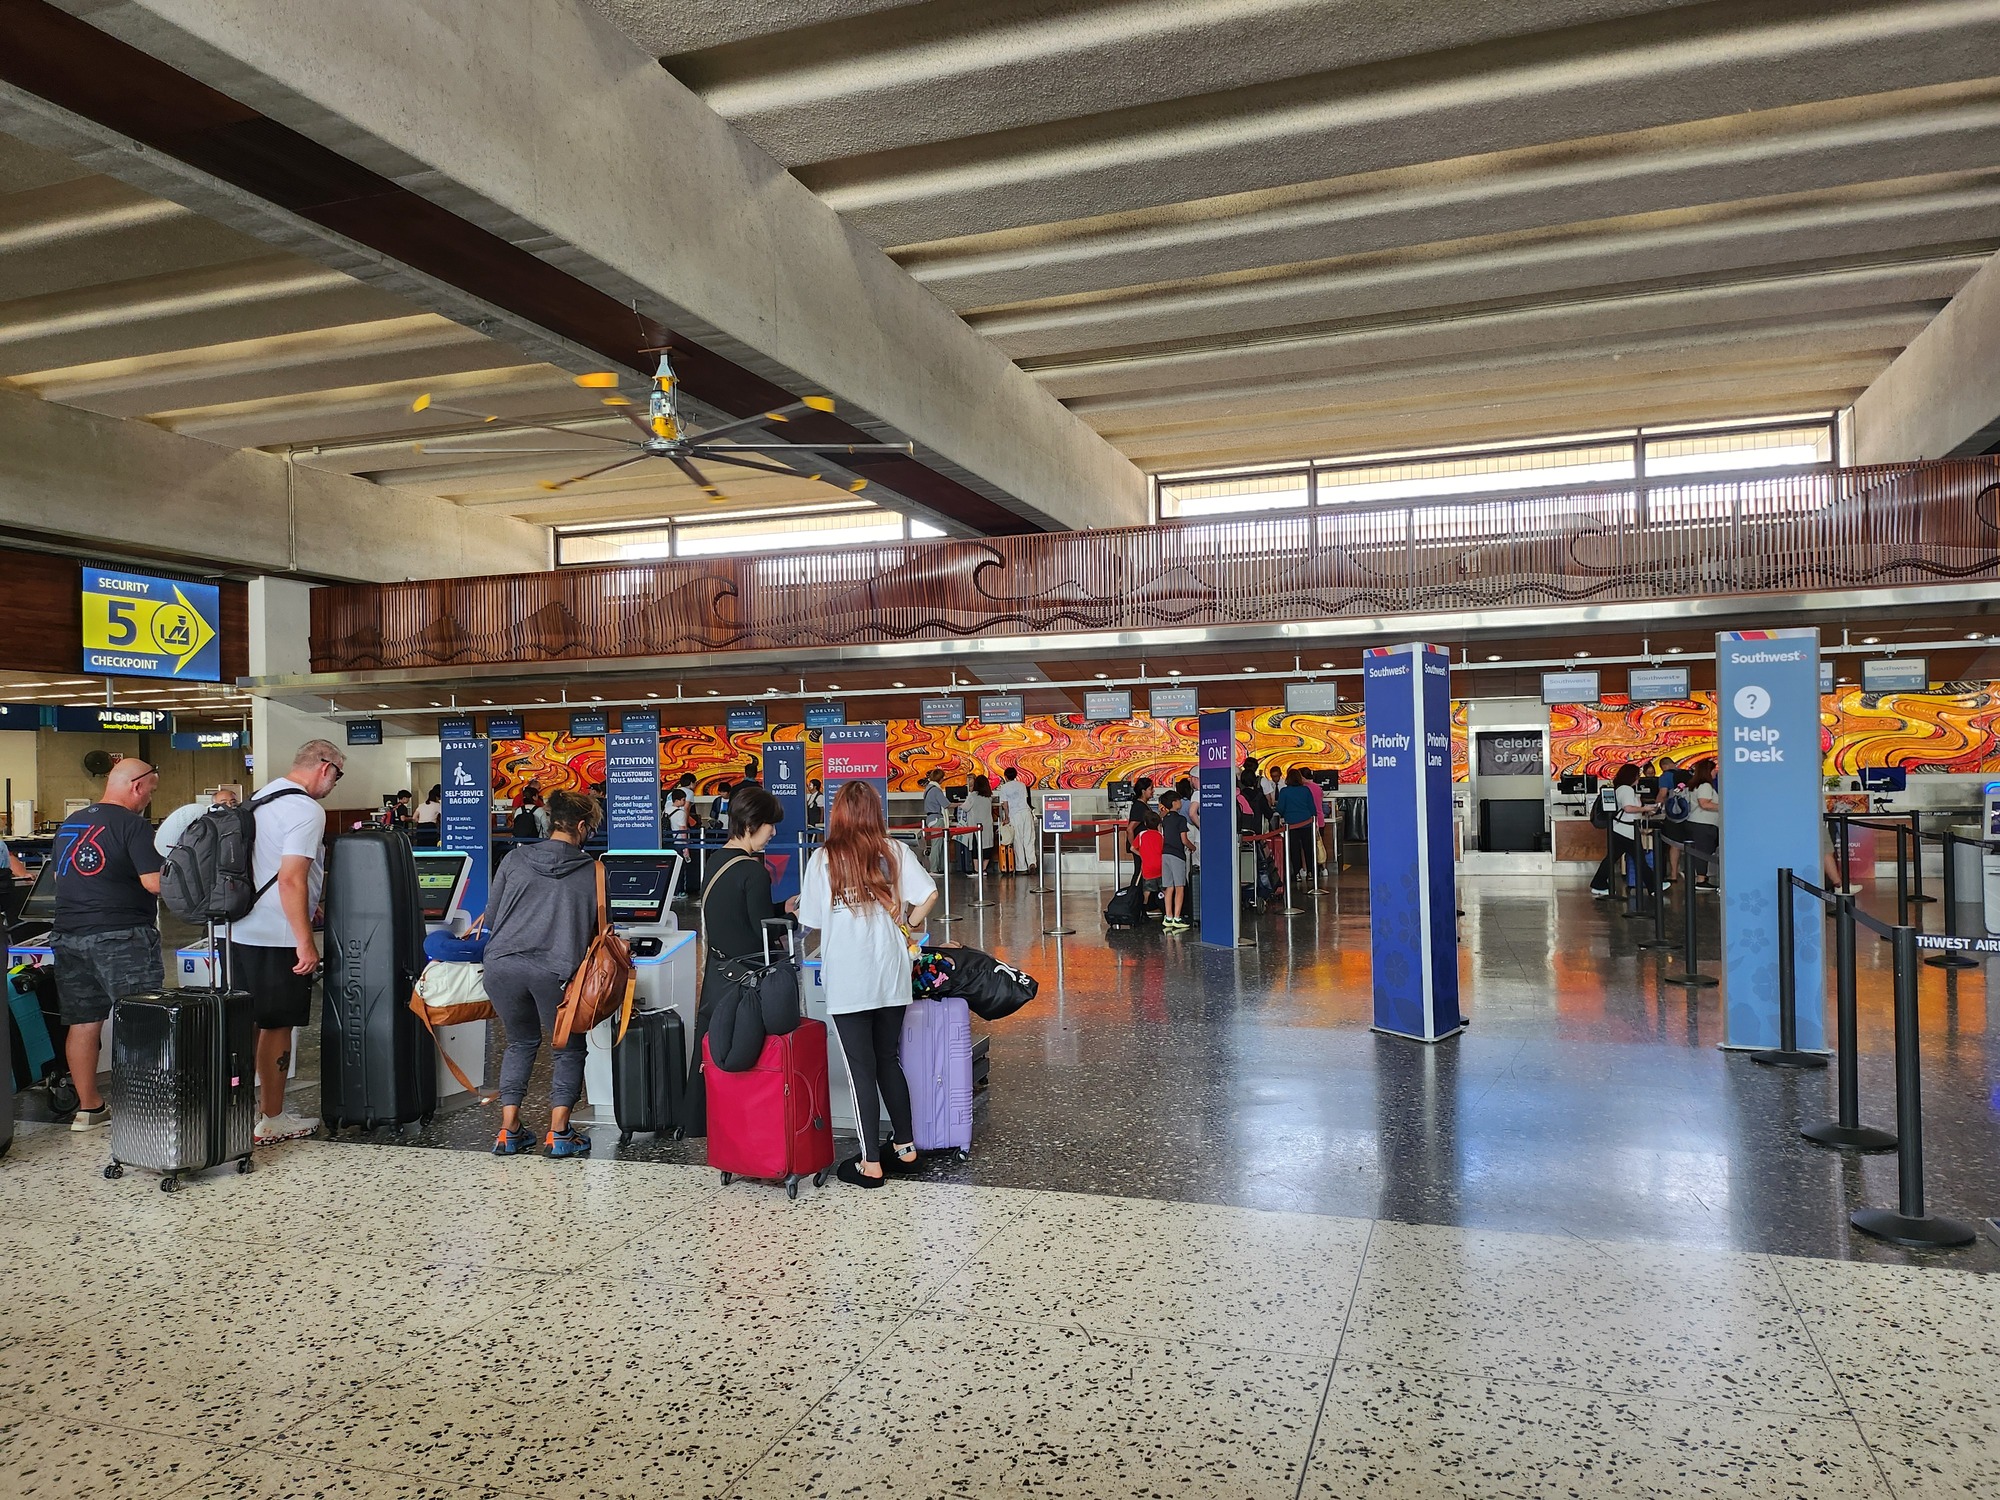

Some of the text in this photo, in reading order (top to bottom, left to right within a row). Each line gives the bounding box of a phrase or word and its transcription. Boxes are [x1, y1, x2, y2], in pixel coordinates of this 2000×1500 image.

[99, 578, 150, 594] SECURITY
[108, 600, 138, 646] 5
[92, 656, 158, 670] CHECKPOINT
[1731, 650, 1800, 664] Southwest
[1370, 665, 1406, 678] Southwest
[1424, 664, 1446, 676] Southwest
[98, 711, 140, 722] All Gates
[1372, 733, 1410, 751] Priority
[1427, 733, 1448, 751] Priority
[1734, 726, 1779, 745] Help
[1208, 746, 1227, 760] ONE
[1428, 752, 1442, 766] Lane
[1495, 751, 1509, 762] of
[1735, 746, 1784, 762] Desk
[610, 757, 654, 765] ATTENTION
[1372, 754, 1396, 767] Lane
[828, 765, 878, 773] PRIORITY
